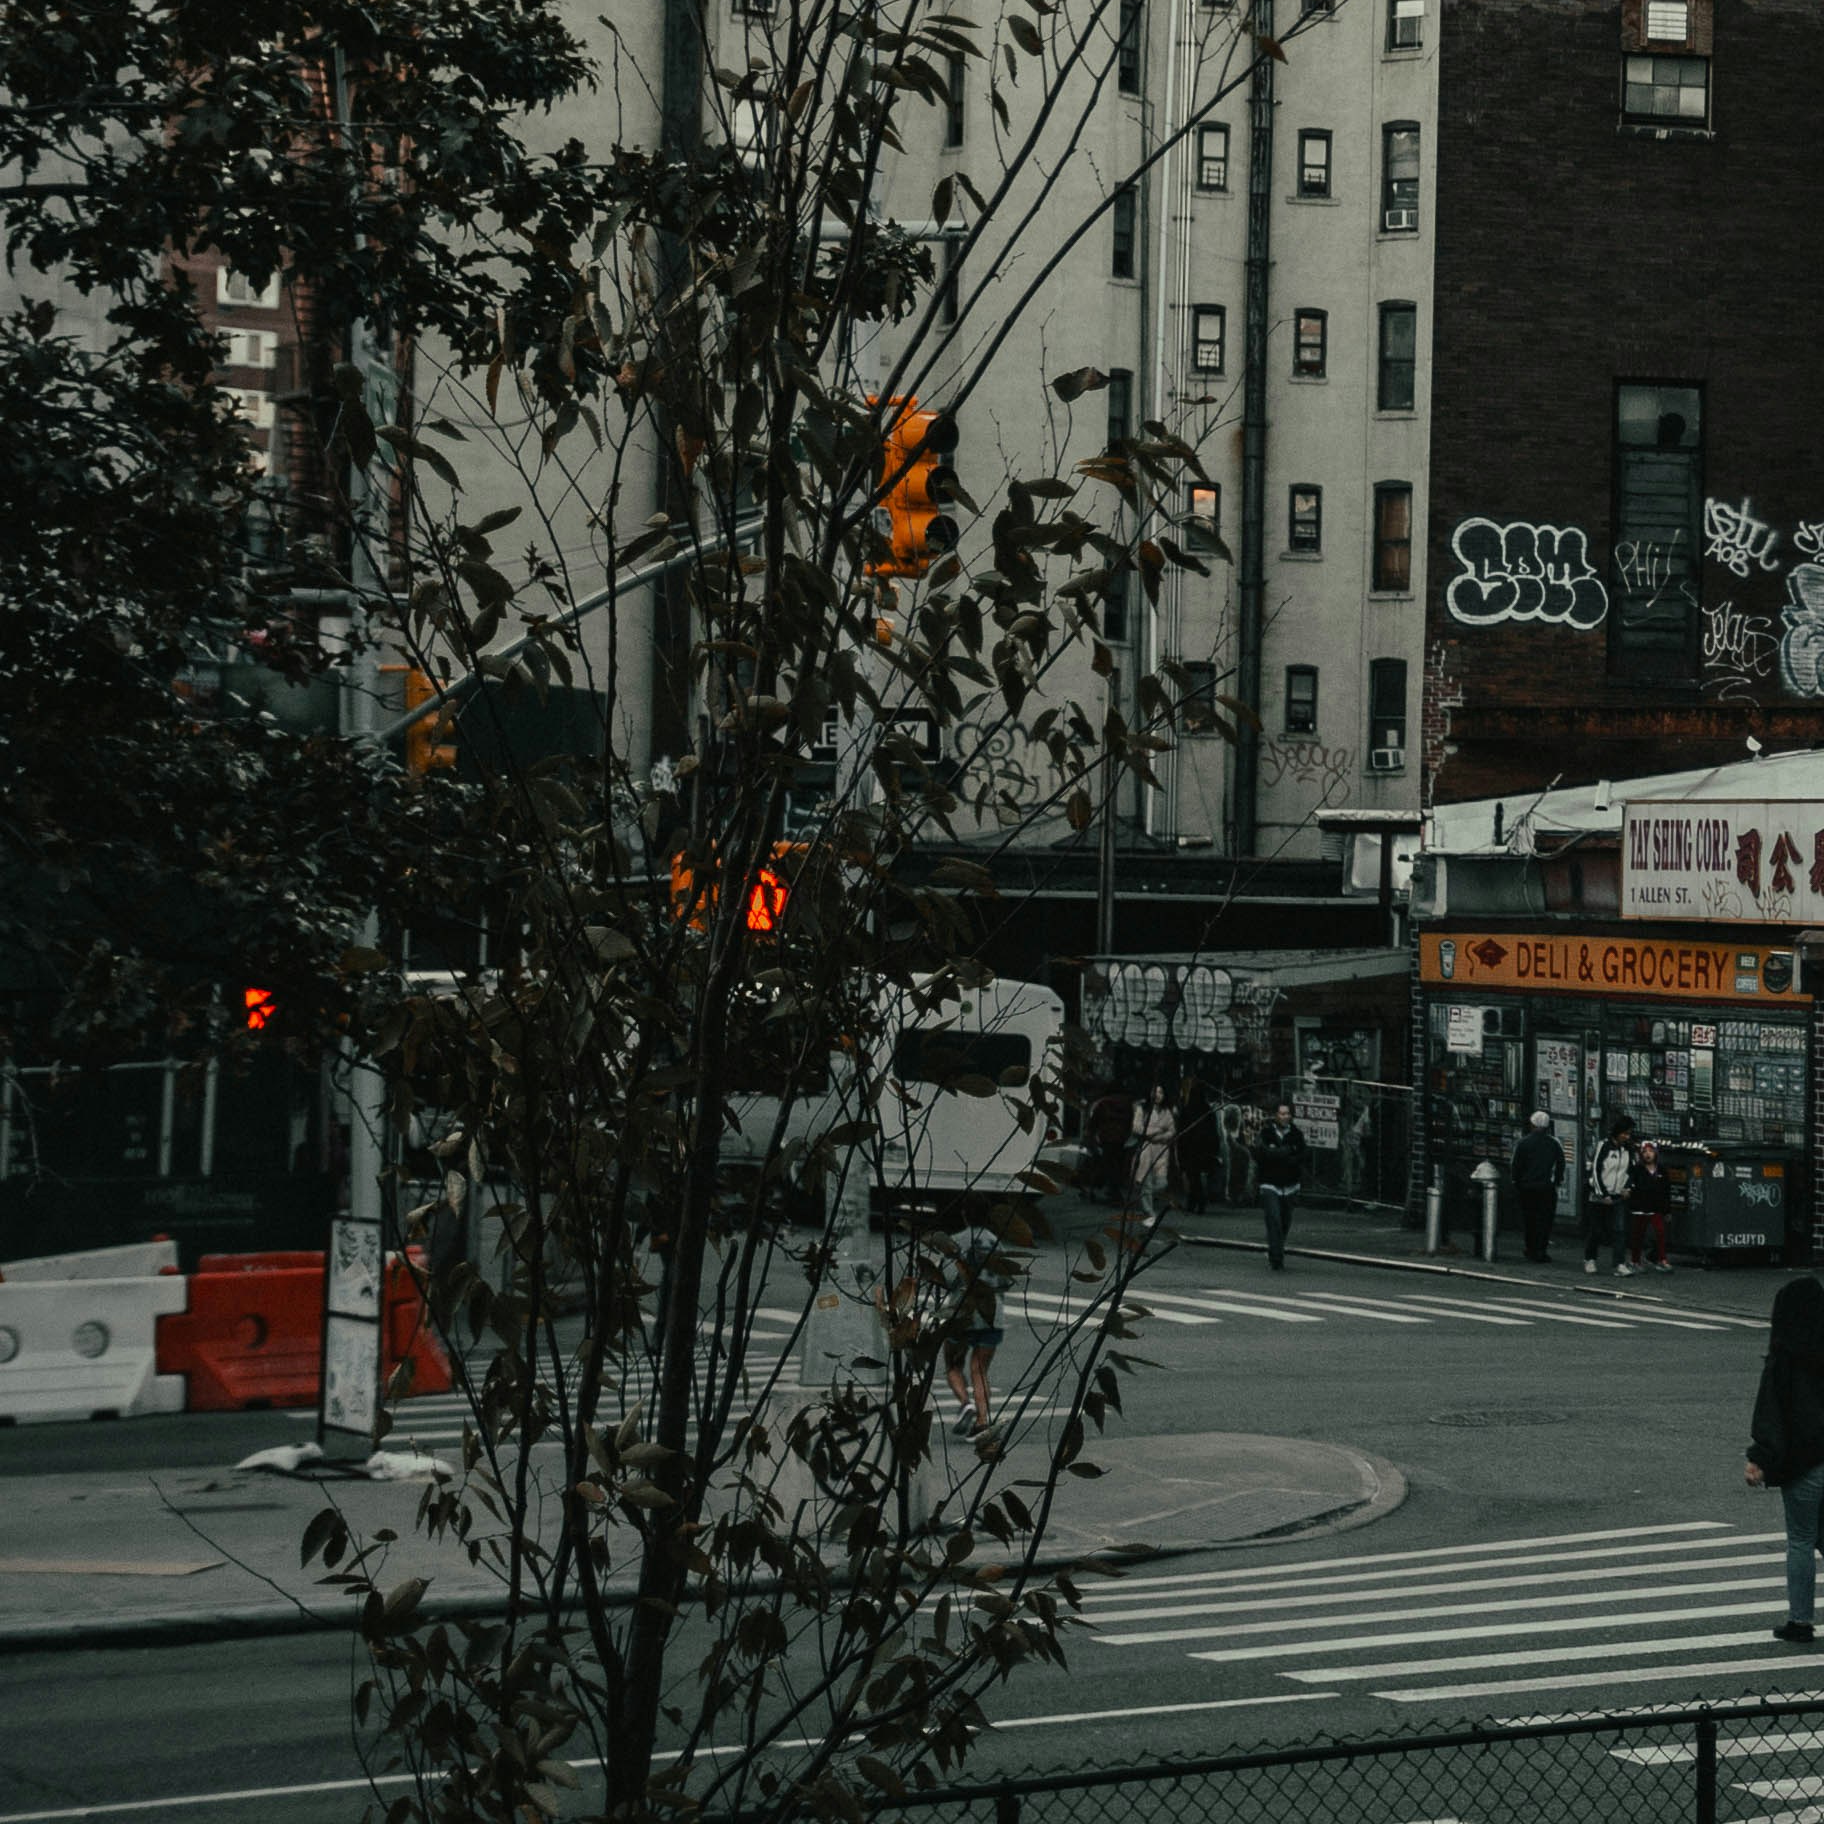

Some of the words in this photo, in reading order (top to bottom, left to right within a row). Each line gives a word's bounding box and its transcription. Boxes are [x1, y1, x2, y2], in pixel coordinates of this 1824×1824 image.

[1630, 819, 1650, 871] TAY
[1652, 819, 1692, 871] SHING
[1695, 818, 1731, 872] CORP.
[1631, 888, 1636, 902] 1
[1639, 887, 1670, 903] ALLEN
[1675, 888, 1692, 904] ST.
[1517, 942, 1569, 979] DELI
[1578, 943, 1595, 982] &
[1602, 945, 1729, 990] GROCERY
